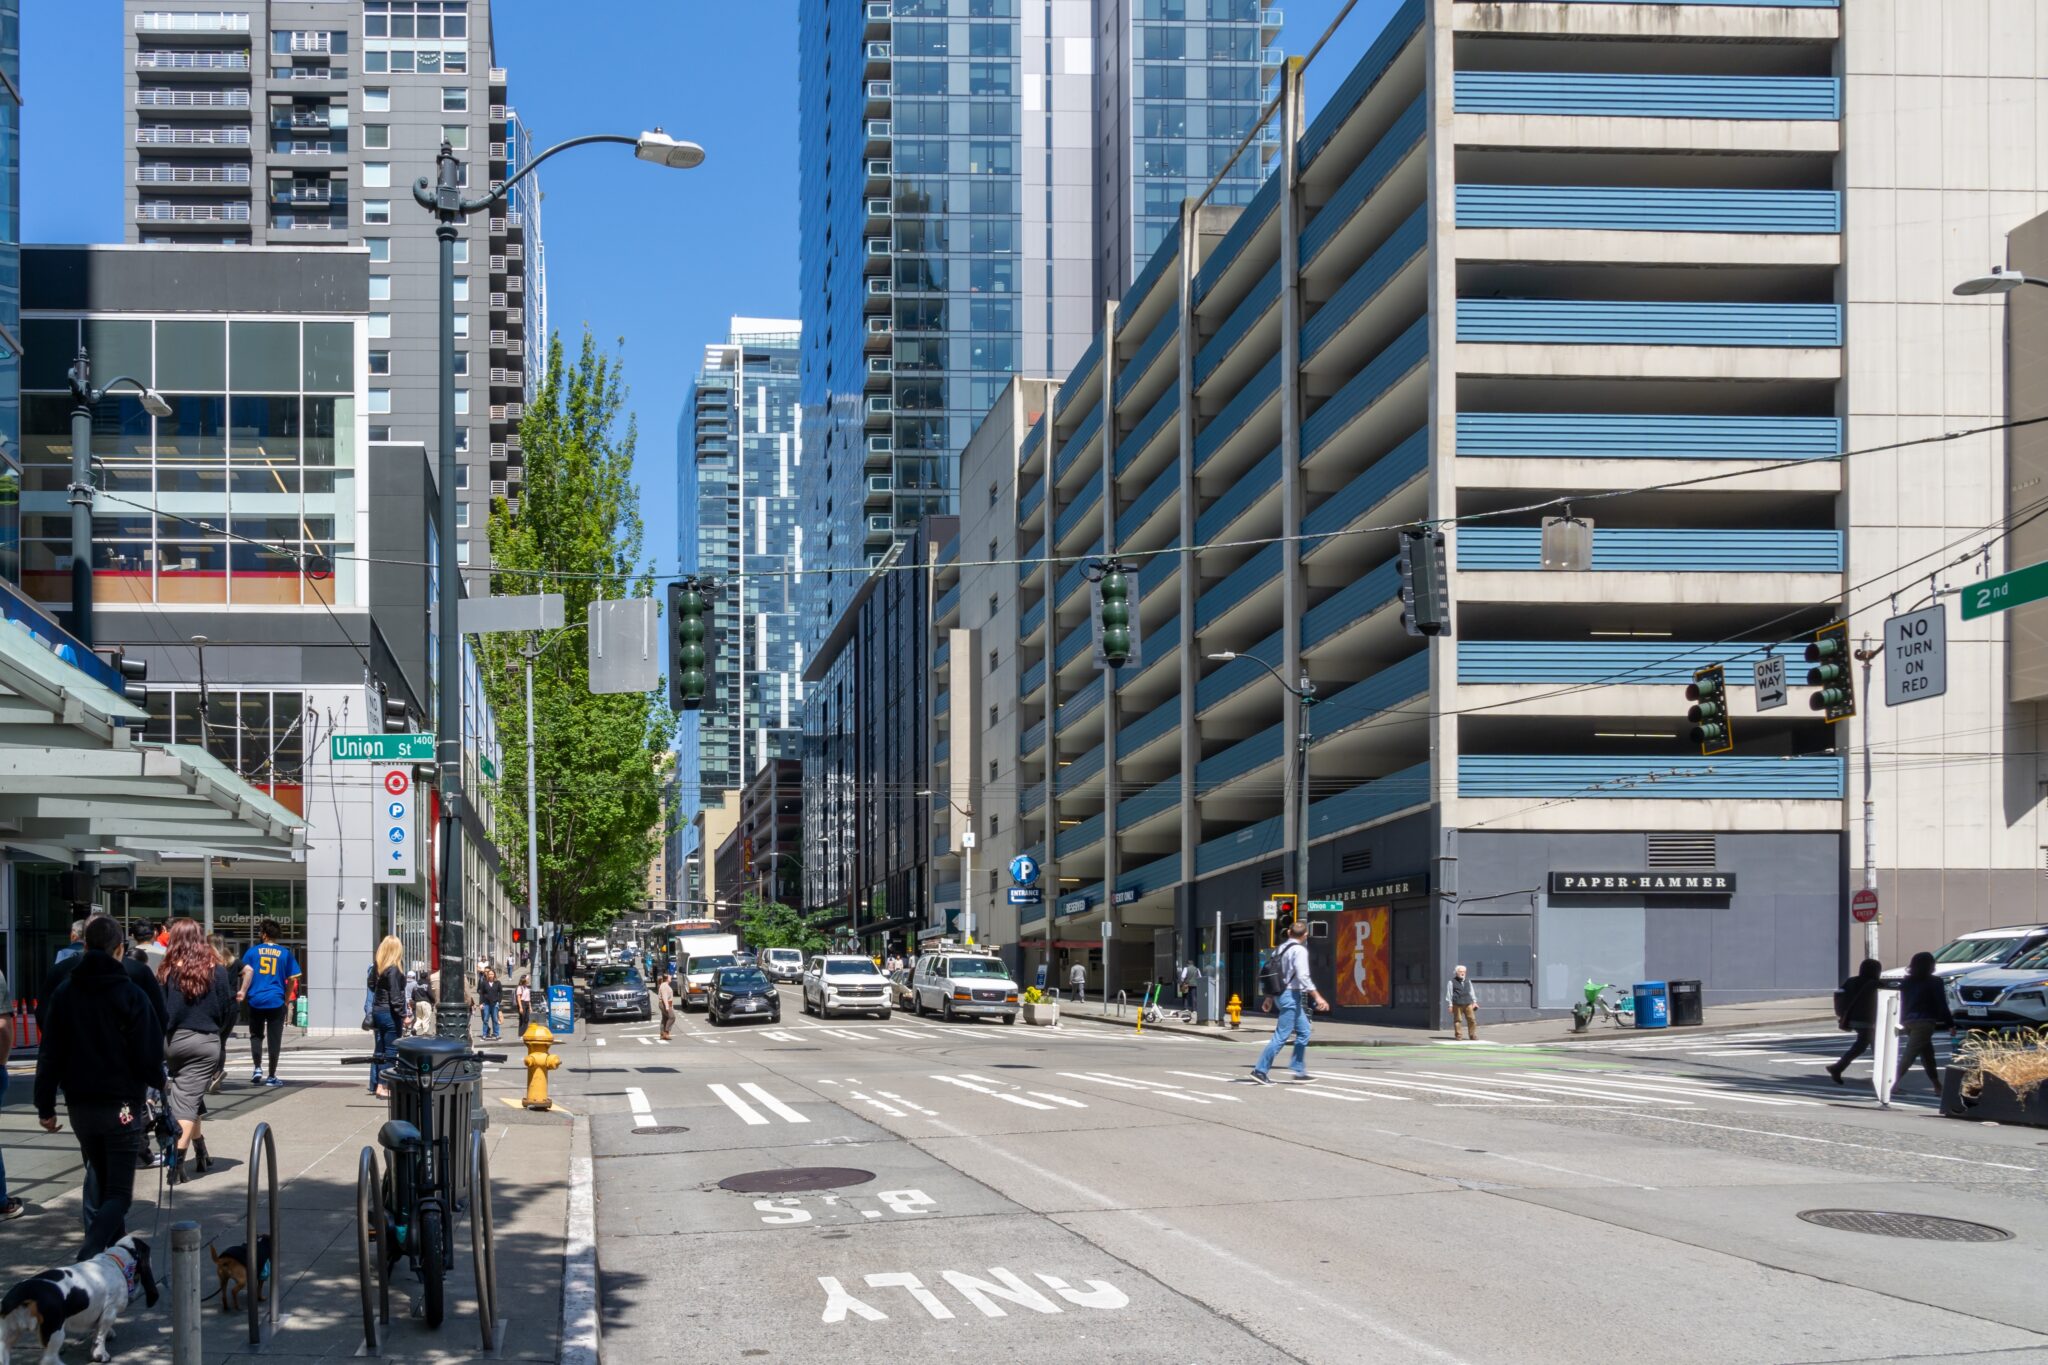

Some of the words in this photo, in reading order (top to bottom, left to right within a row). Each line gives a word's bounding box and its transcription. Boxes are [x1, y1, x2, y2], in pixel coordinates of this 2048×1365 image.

[1976, 582, 2009, 609] 2nd
[1900, 619, 1928, 641] NO
[1896, 639, 1933, 660] TURN
[1757, 661, 1780, 676] ONE
[1905, 659, 1924, 675] ON
[1758, 674, 1781, 690] WAY
[1902, 676, 1929, 694] RED
[336, 738, 384, 756] Union
[398, 743, 412, 756] St
[413, 736, 433, 745] 1400
[392, 805, 403, 816] P
[1020, 861, 1034, 880] P
[1564, 877, 1629, 887] PAPER
[1639, 877, 1727, 888] HAMMER
[1010, 889, 1039, 897] ENTRANCE
[1325, 890, 1357, 901] PAPER
[1361, 882, 1410, 898] HAMMER
[1309, 902, 1327, 910] Union
[220, 914, 252, 923] order
[259, 957, 278, 975] 51
